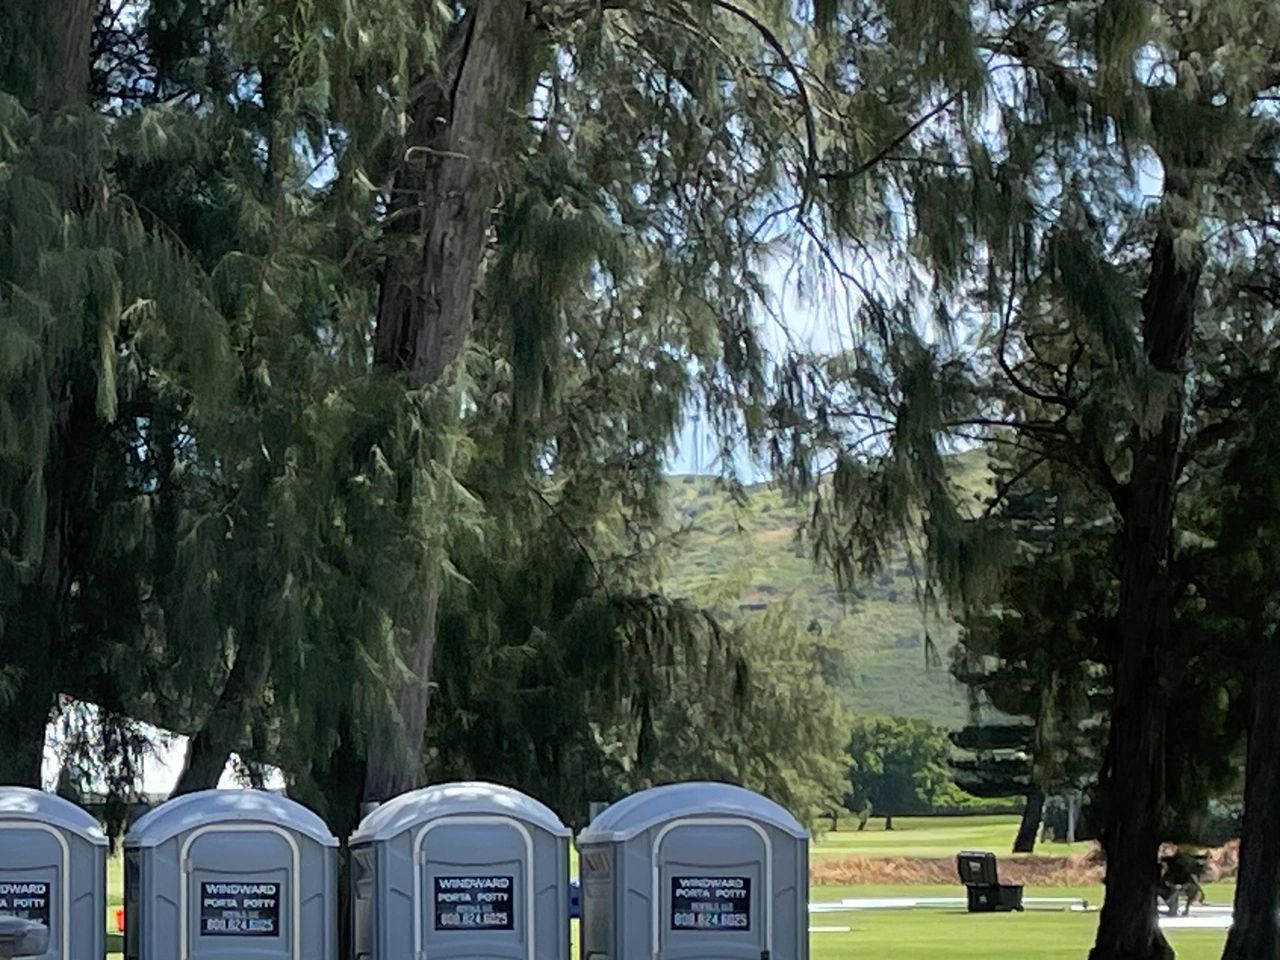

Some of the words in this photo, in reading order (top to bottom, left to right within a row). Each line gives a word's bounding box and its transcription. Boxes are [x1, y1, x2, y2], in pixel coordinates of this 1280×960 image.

[439, 879, 509, 889] WINDWARD
[679, 878, 744, 888] WINDWARD
[205, 884, 276, 895] WINDWARD
[676, 888, 710, 898] PORTA
[715, 888, 747, 898] POTTY
[437, 893, 471, 902] PORTA
[477, 893, 508, 902] POTTY
[13, 898, 45, 908] POTTY
[204, 898, 237, 908] PORTA
[244, 898, 276, 908] POTTY
